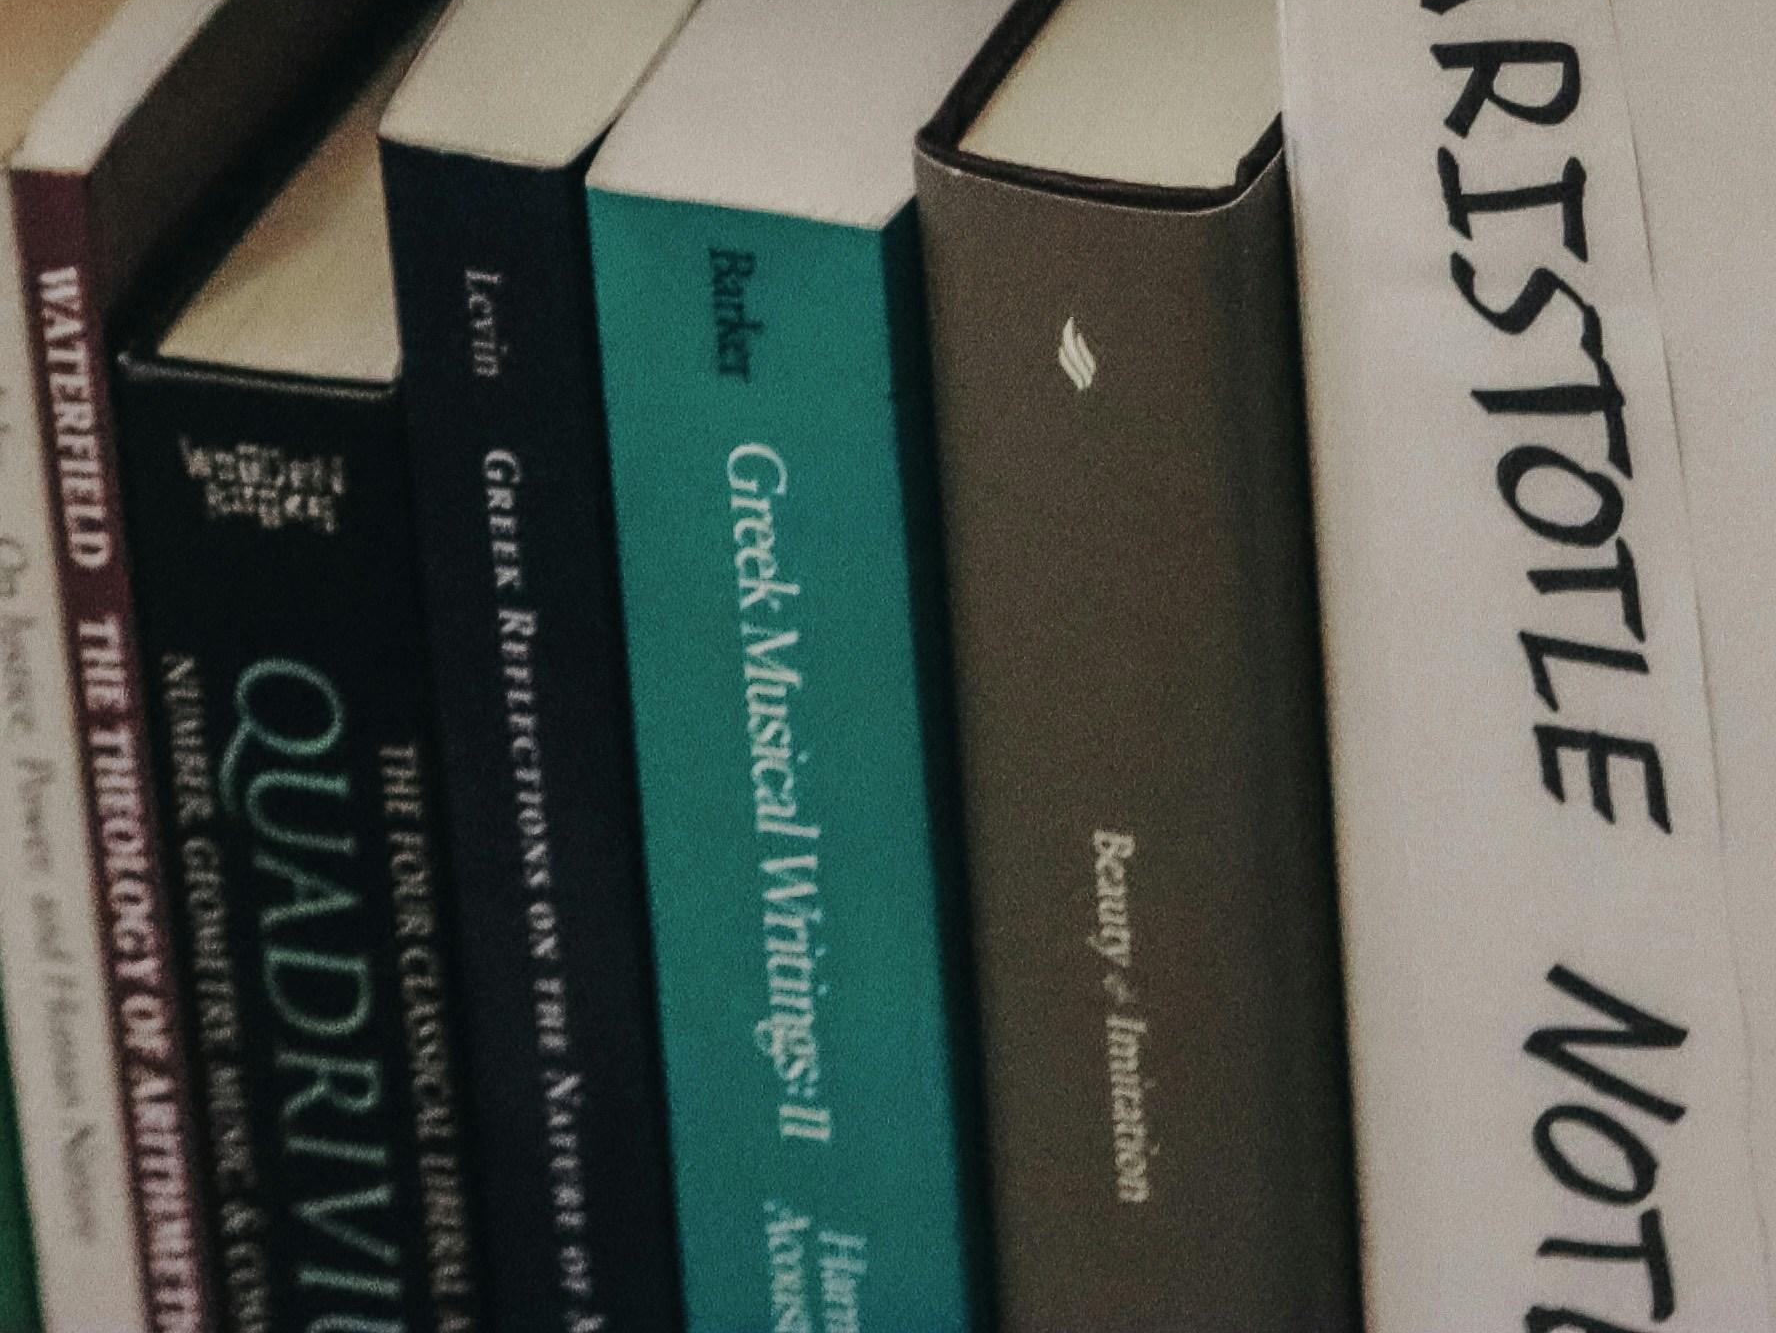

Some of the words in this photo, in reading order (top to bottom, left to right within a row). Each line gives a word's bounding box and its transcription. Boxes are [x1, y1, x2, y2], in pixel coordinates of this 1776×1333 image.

[40, 266, 113, 569] WATERFIELD
[709, 247, 764, 383] Barker
[456, 268, 508, 379] Levin
[483, 447, 523, 589] GREEK
[727, 441, 801, 613] Greek
[80, 617, 131, 718] THE
[741, 622, 822, 839] Musical
[90, 729, 160, 981] THEOLOGY
[1086, 829, 1137, 968] Beauty
[755, 854, 827, 1099] Writings:
[1106, 1013, 1162, 1203] Imitation
[1522, 962, 1689, 1333] NOT
